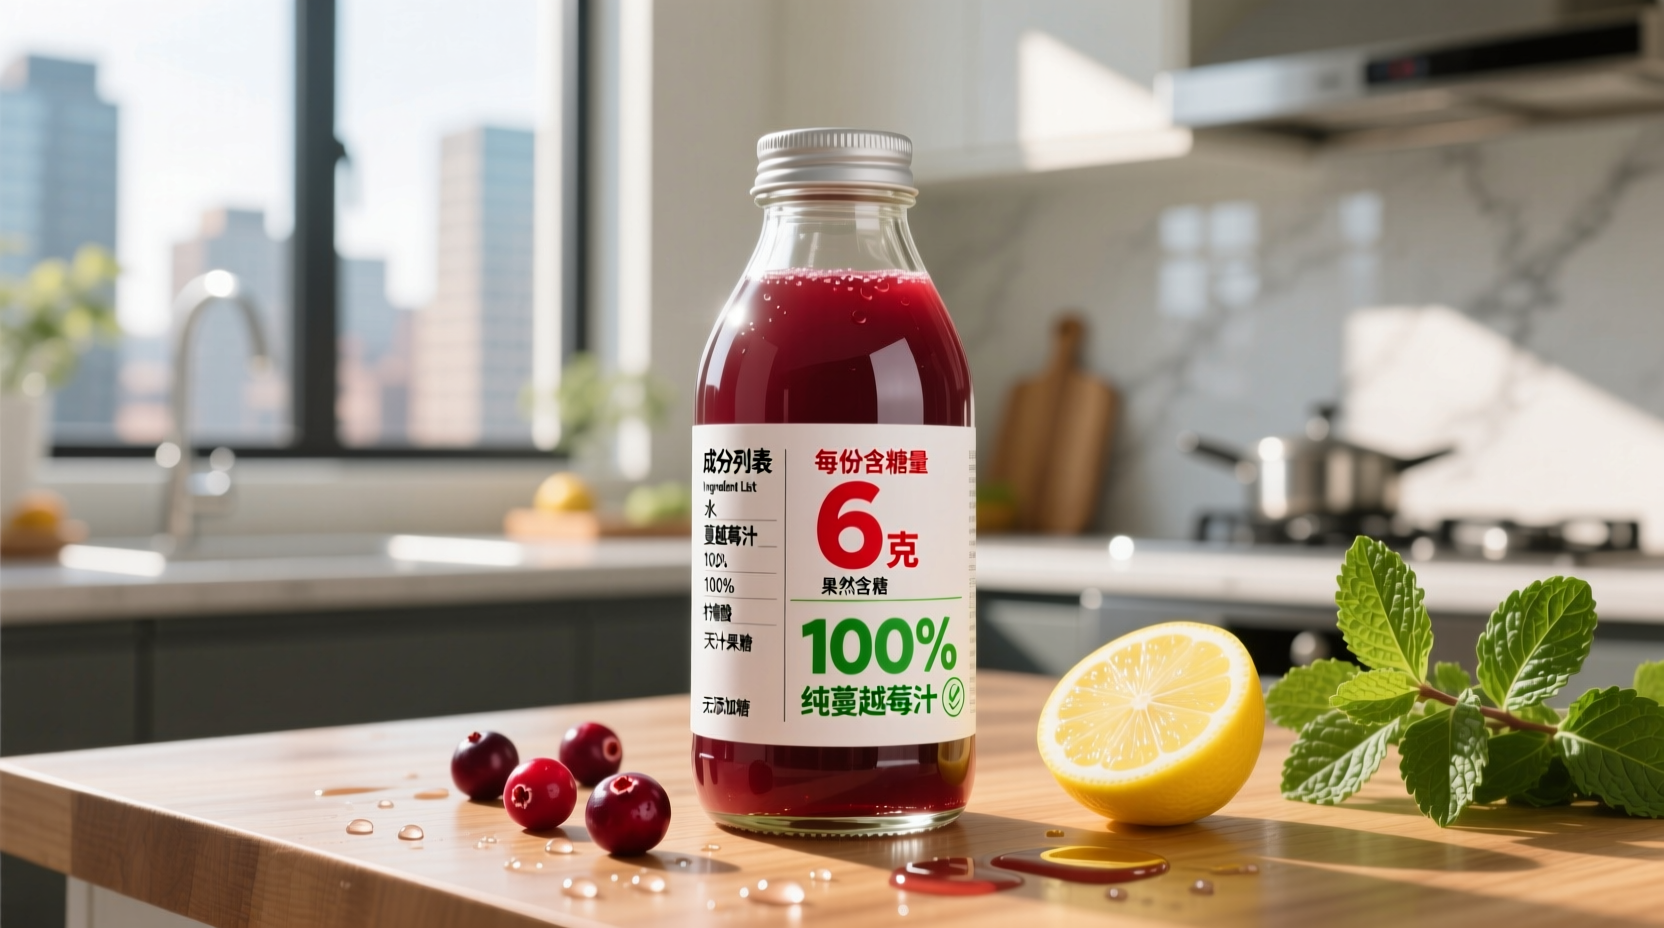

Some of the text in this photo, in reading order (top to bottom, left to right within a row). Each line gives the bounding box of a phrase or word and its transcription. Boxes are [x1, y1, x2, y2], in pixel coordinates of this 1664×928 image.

[703, 448, 773, 474] 成分列表
[814, 448, 928, 475] 每份含糖量
[704, 499, 717, 518] 水
[704, 577, 735, 593] 100%
[802, 616, 957, 675] 100%
[801, 683, 938, 717] 纯蔓越莓汁
